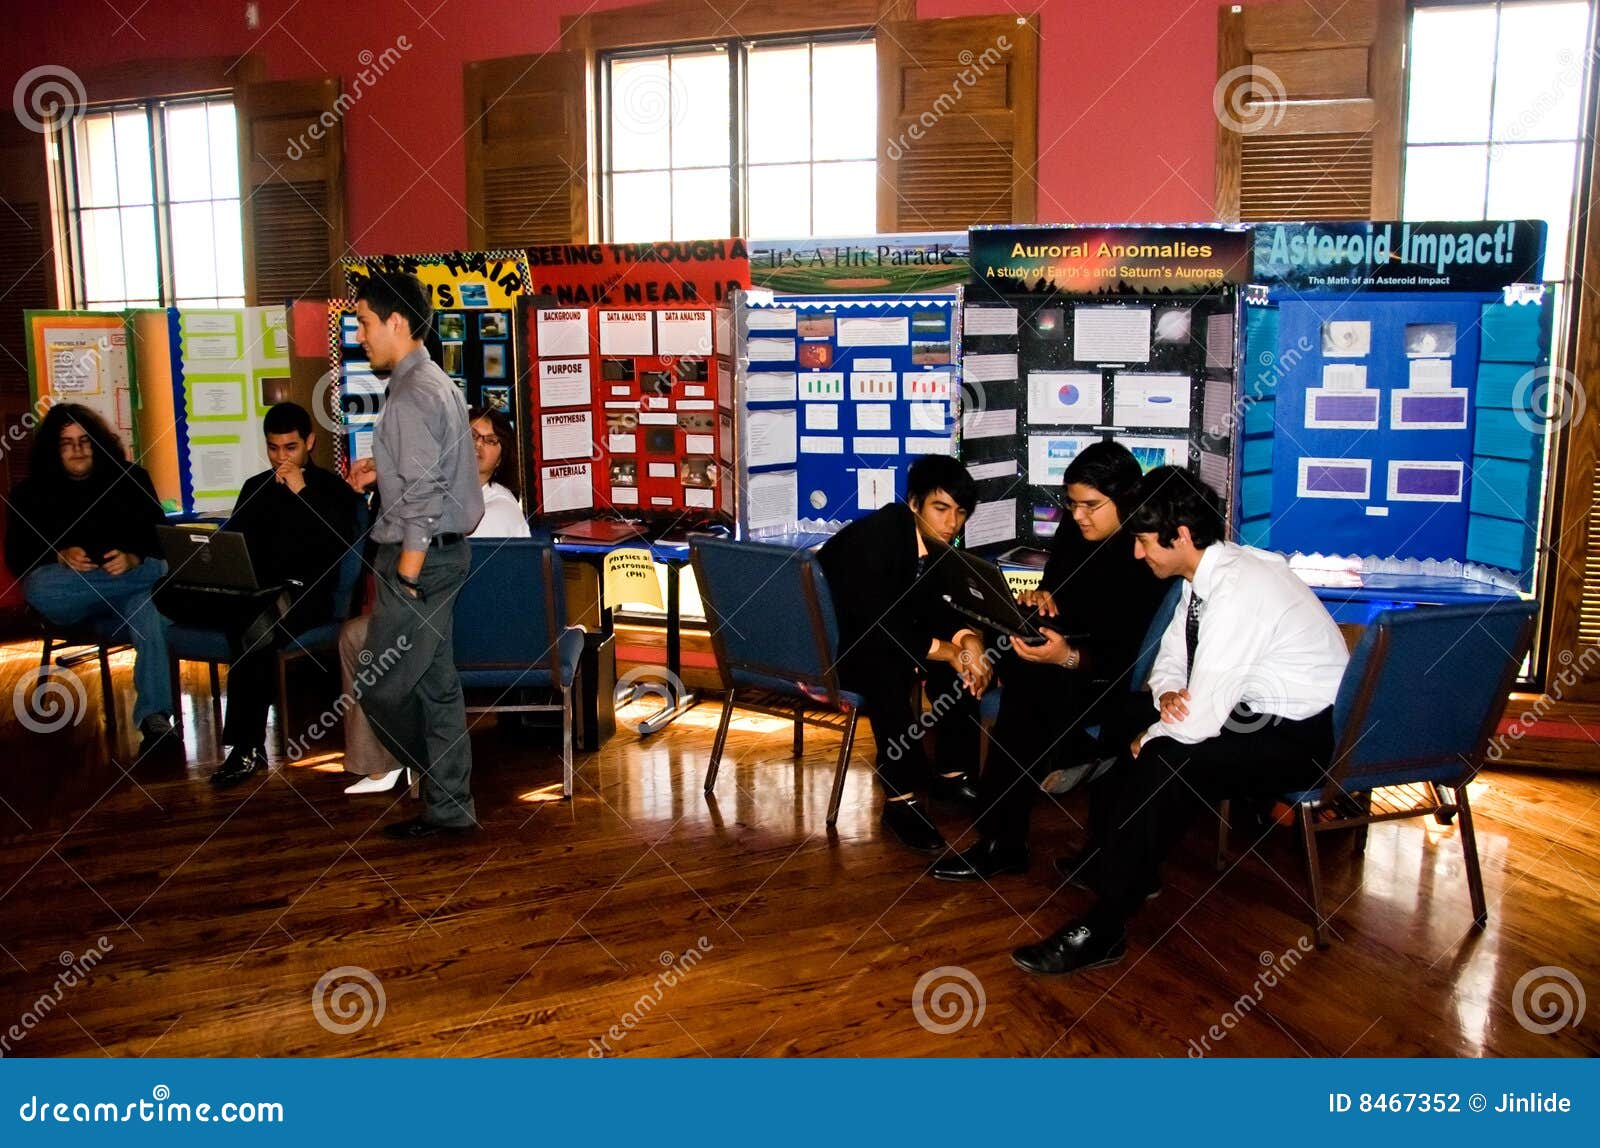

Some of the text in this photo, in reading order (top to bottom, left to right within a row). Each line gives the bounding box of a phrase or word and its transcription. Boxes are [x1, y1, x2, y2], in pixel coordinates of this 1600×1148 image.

[528, 239, 748, 266] SEEING THROUGH A
[809, 248, 826, 268] A
[834, 245, 870, 267] Hit
[877, 243, 952, 267] Parade
[1010, 242, 1213, 258] Auroral Anomalies
[1269, 222, 1516, 275] Asteroid Impact!
[448, 250, 522, 297] HAIR
[986, 266, 1224, 280] A study of Earth's and Saturn's Auroras
[1308, 276, 1450, 286] The Math of an Asteroid Impact
[623, 281, 698, 304] NEAR
[543, 311, 582, 321] BACKGROUND
[606, 312, 647, 321] DATA ANALYSIS
[665, 311, 706, 321] DATA ANALYSIS
[547, 364, 582, 375] PURPOSE
[546, 414, 586, 425] HYPOTHESIS
[549, 465, 587, 479] MATERIALS
